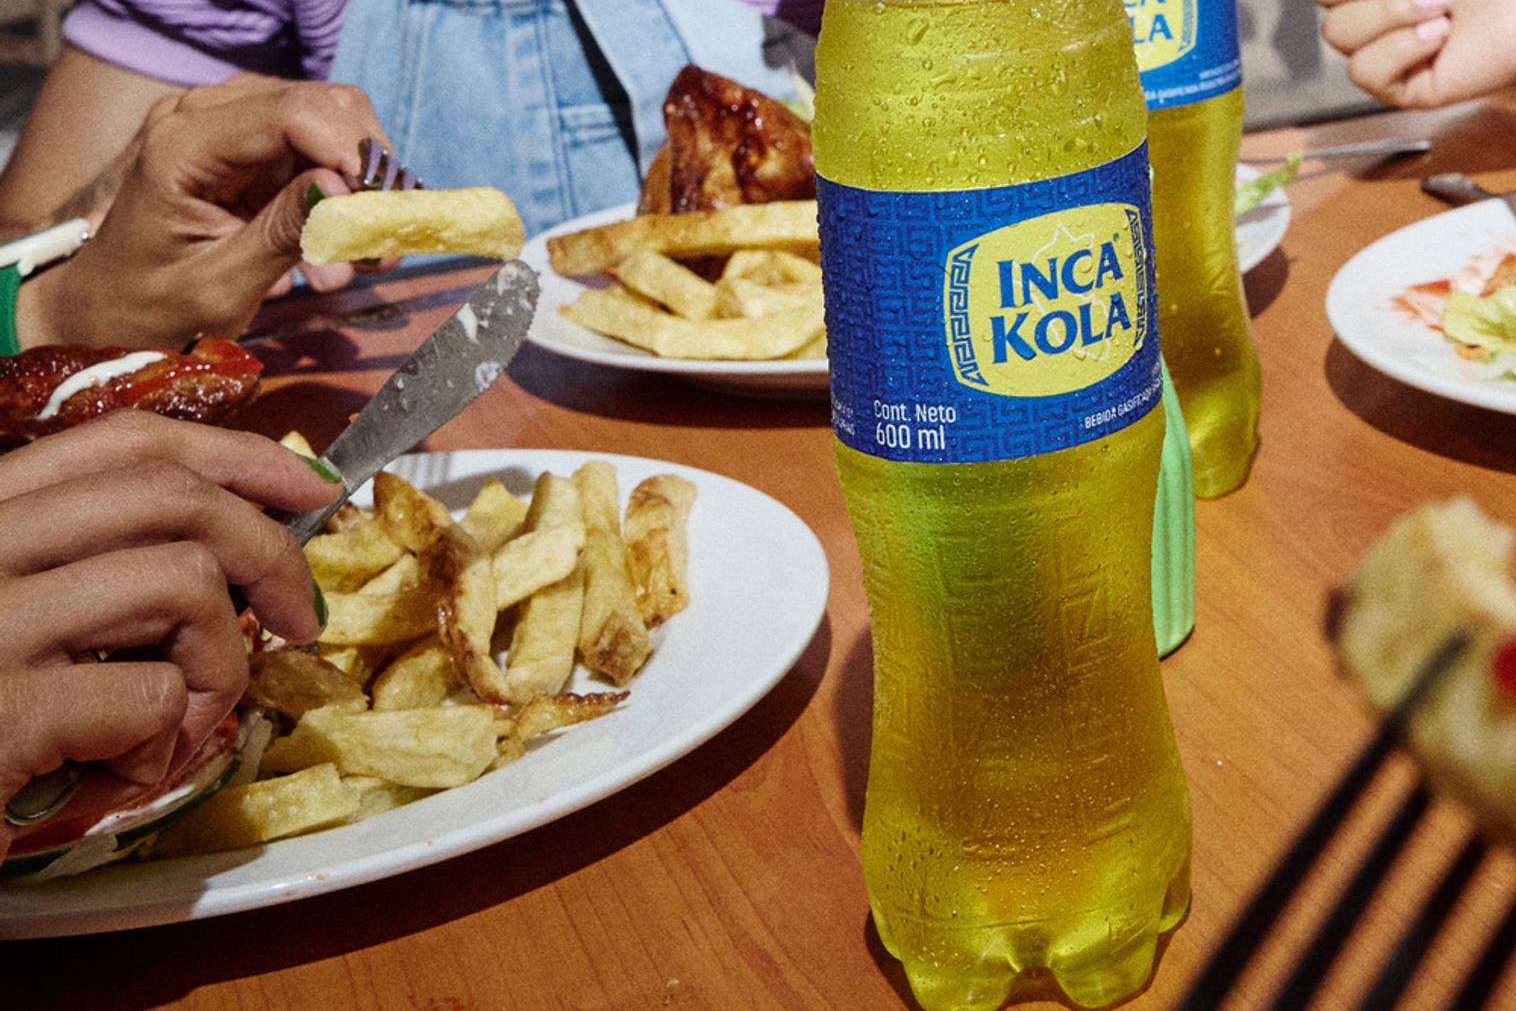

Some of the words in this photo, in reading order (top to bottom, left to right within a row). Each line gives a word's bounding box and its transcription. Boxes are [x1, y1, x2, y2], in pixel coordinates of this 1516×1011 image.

[1129, 14, 1174, 44] LA
[997, 241, 1124, 309] INCA
[989, 291, 1132, 365] KOLA
[873, 399, 911, 422] Cont.
[915, 404, 957, 423] Neto
[876, 422, 911, 449] 600
[918, 424, 946, 450] ml
